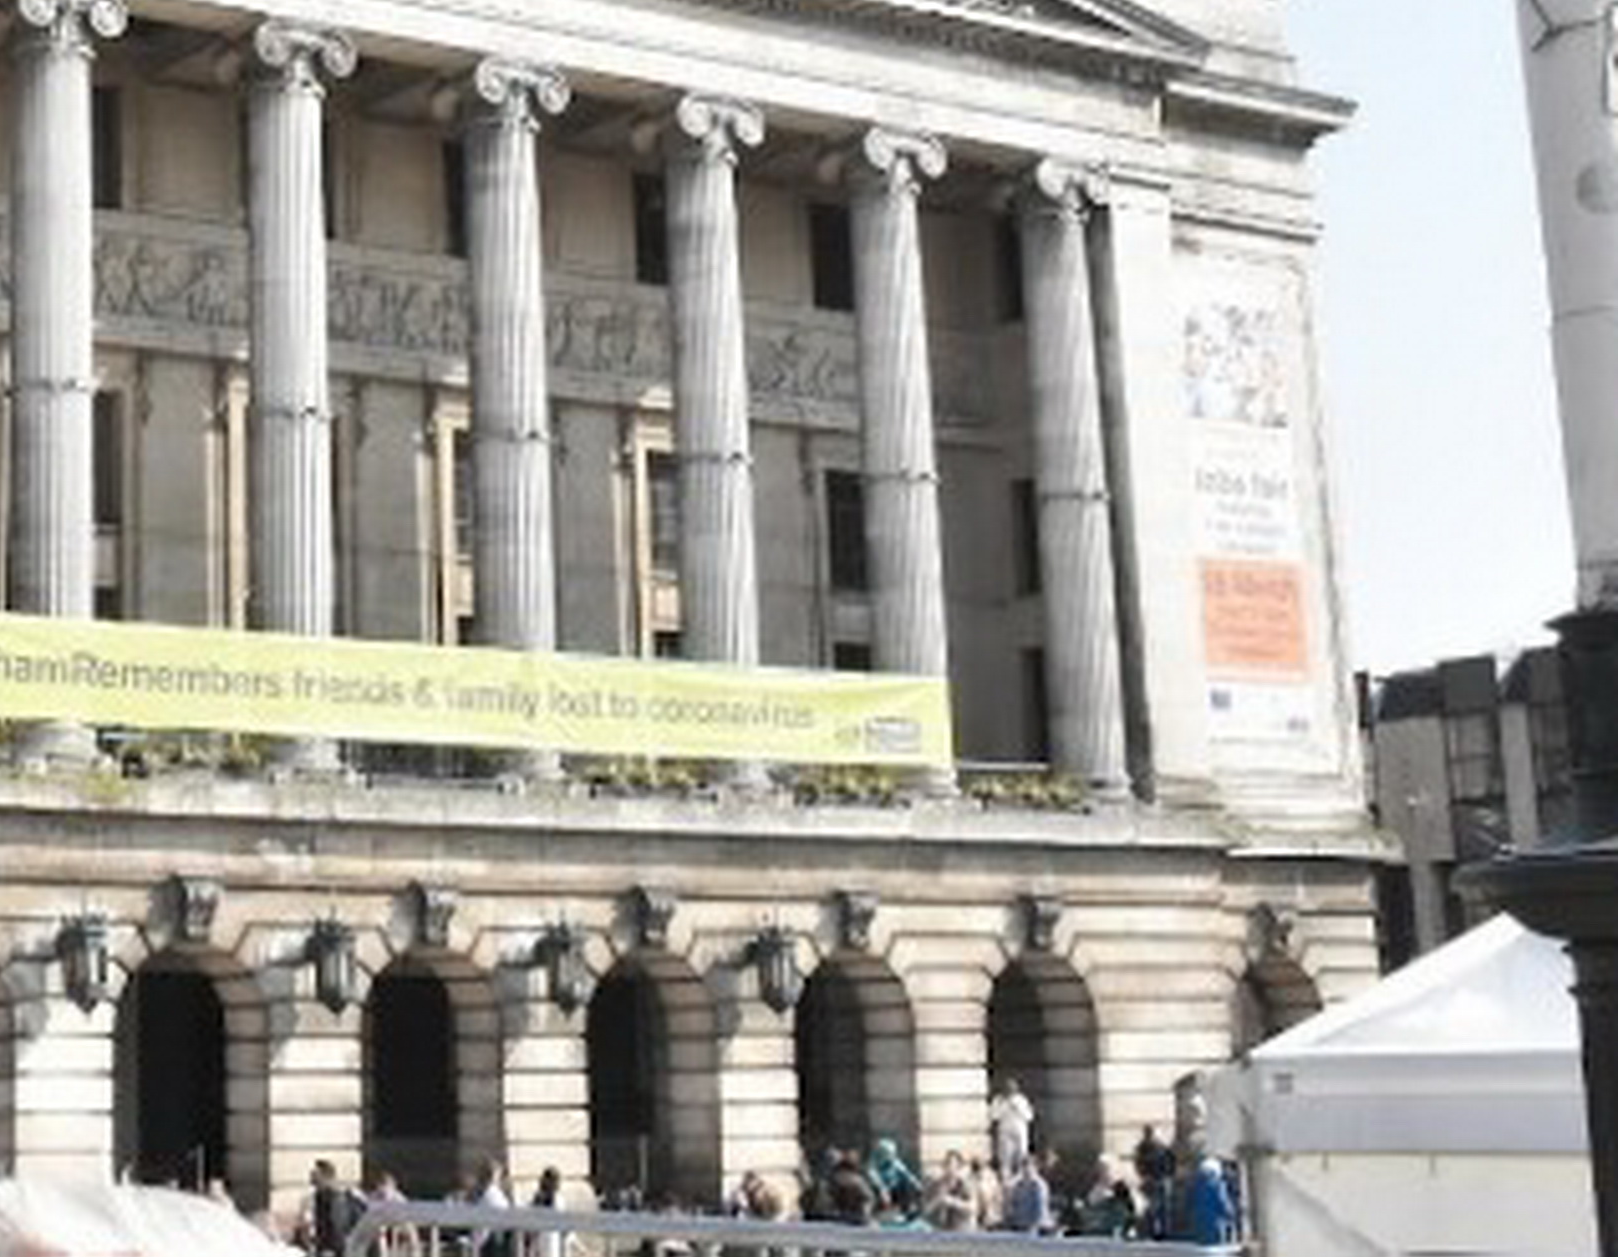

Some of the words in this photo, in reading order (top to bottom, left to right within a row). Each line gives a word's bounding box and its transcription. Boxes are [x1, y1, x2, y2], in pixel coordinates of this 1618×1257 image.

[292, 668, 405, 707] friends
[443, 678, 540, 721] family
[547, 689, 604, 720] lost
[609, 694, 640, 722] to
[646, 698, 817, 731] coronavirus
